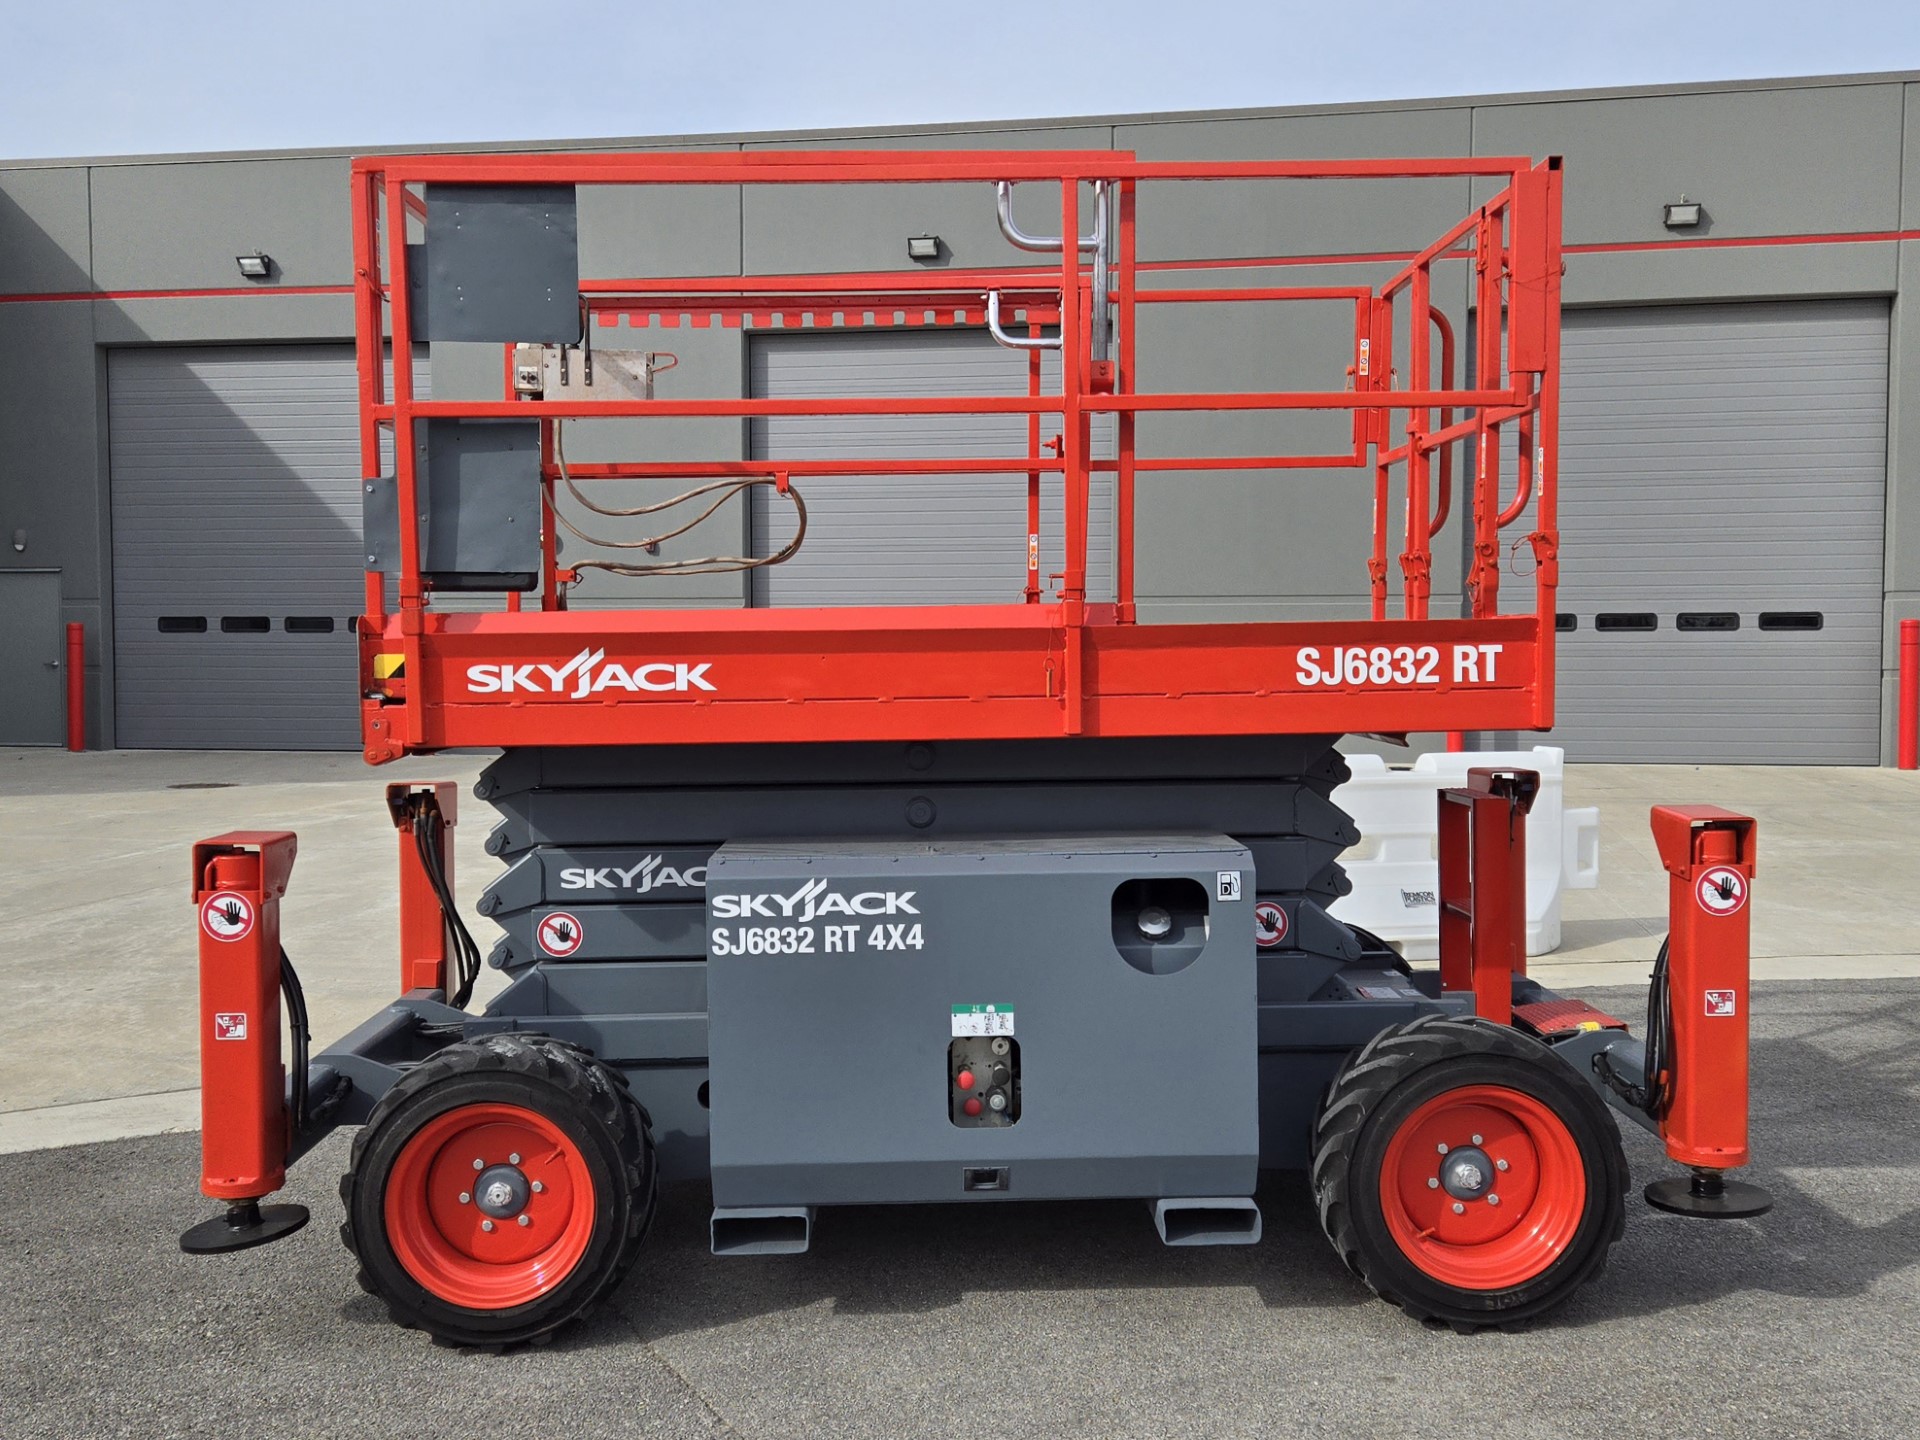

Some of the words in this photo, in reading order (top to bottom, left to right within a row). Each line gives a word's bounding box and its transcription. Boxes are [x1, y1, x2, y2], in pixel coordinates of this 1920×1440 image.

[466, 647, 718, 699] SKYJACK
[1295, 646, 1440, 686] SJ6832
[1453, 644, 1503, 683] RT
[559, 854, 706, 893] SKYJAC
[711, 877, 921, 922] SKYJACK
[711, 926, 815, 956] SJ6832
[824, 925, 860, 953] RT
[867, 923, 925, 951] 4X4
